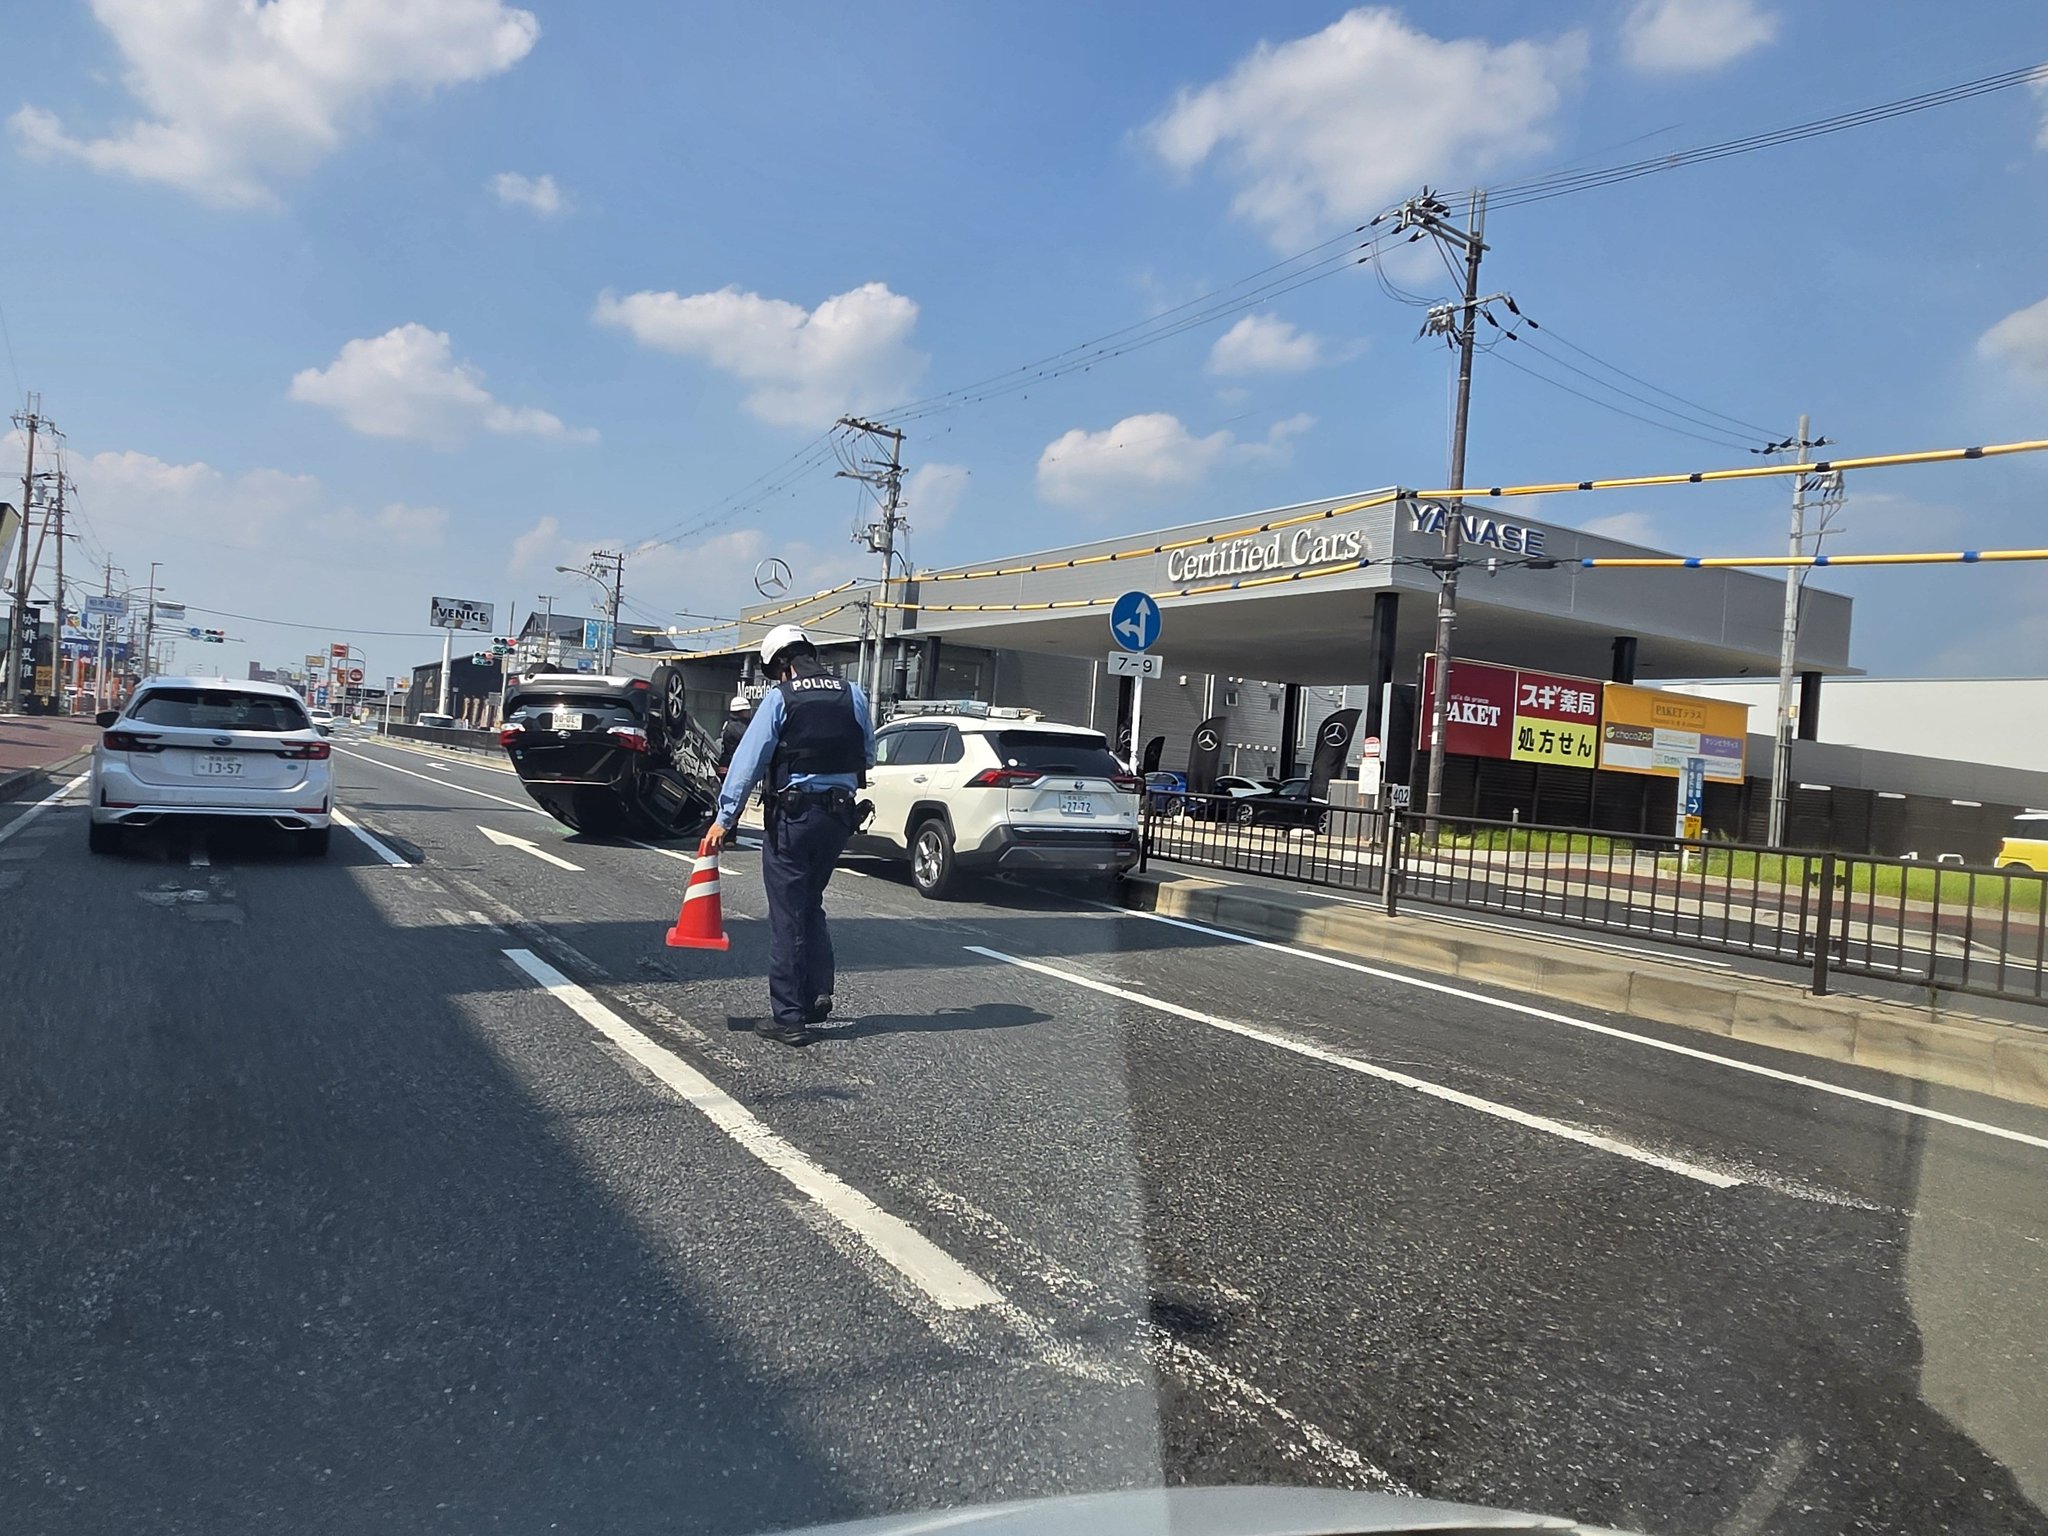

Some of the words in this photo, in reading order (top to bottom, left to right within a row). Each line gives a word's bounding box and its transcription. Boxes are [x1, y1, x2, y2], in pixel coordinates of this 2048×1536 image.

[1404, 502, 1546, 558] YANASE
[1168, 533, 1283, 582] Certified
[1291, 528, 1362, 566] Cars
[438, 607, 487, 622] VENICE
[1118, 656, 1153, 673] 7-9
[791, 679, 842, 691] POLICE
[1519, 684, 1596, 716] スギ薬局
[1517, 726, 1592, 758] 処方せん
[1393, 788, 1409, 804] 402
